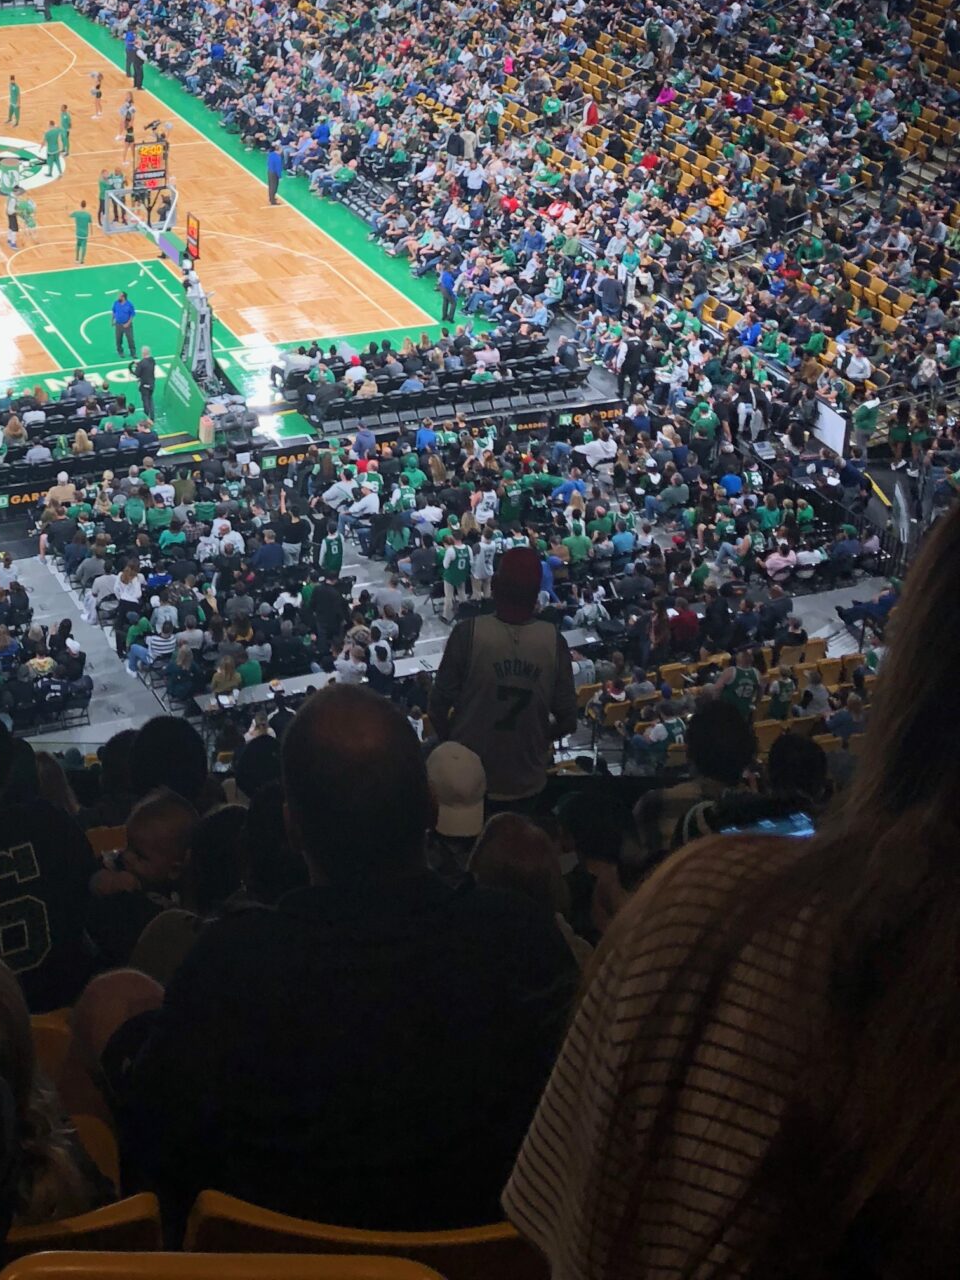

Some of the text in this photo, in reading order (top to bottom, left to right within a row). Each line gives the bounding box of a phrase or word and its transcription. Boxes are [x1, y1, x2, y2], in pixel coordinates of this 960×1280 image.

[573, 409, 623, 424] GDEN
[277, 454, 306, 466] GAR
[494, 659, 540, 682] BROWN
[496, 685, 533, 732] 7
